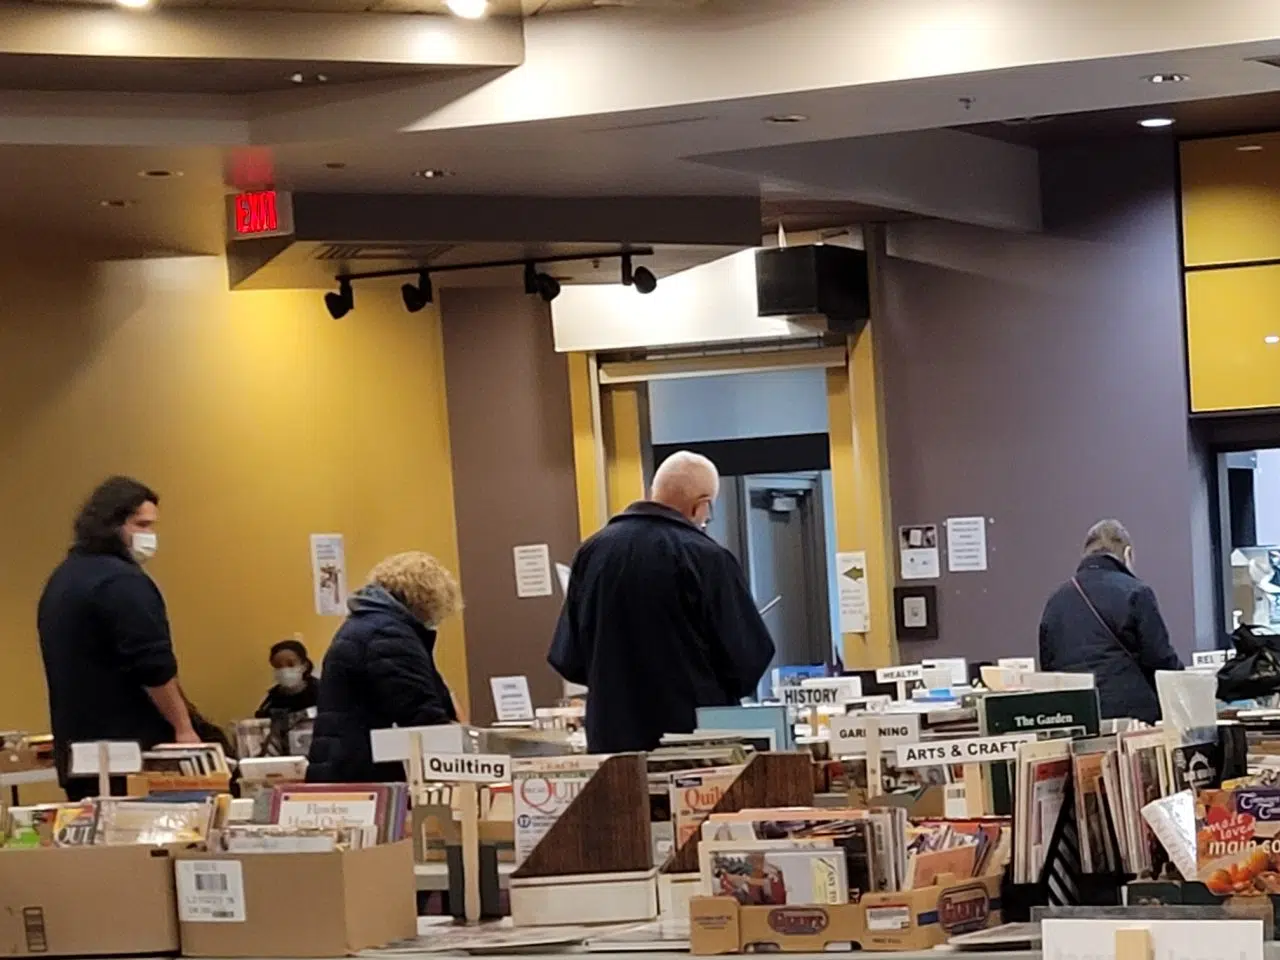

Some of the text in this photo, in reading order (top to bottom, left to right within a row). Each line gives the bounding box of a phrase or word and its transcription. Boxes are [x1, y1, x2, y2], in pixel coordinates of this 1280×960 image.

[235, 191, 278, 233] EXIT
[883, 670, 919, 679] HEALTH
[784, 687, 839, 704] HISTORY
[1014, 712, 1073, 726] The Garden
[839, 727, 909, 740] GARNING
[906, 740, 1029, 761] ARTS & CRAFT
[429, 758, 505, 778] Quilting
[1209, 834, 1256, 855] main
